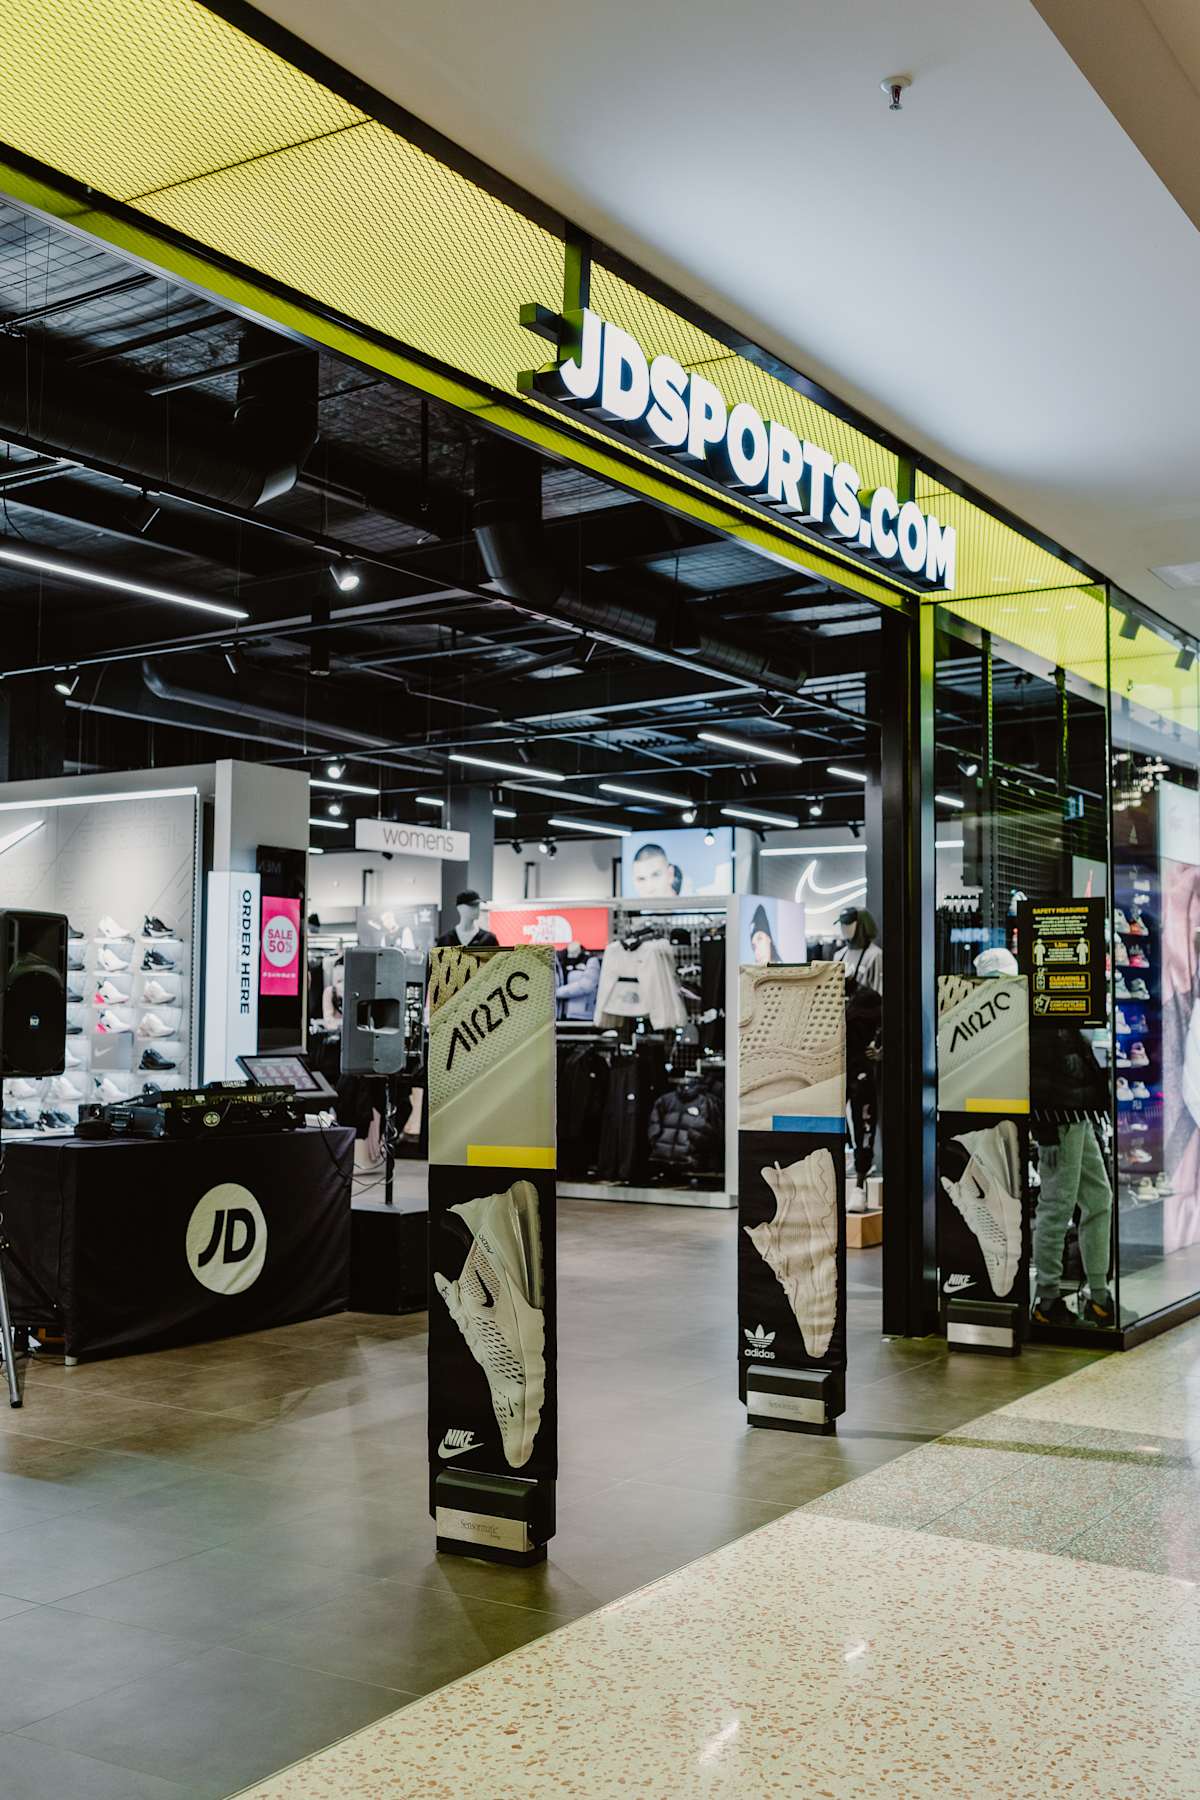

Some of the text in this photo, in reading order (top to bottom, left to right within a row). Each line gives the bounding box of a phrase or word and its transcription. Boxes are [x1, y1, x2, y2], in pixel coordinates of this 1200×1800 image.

[559, 307, 957, 590] JDSPORTS.COM
[383, 828, 454, 853] womens
[268, 928, 293, 941] SALE
[240, 889, 252, 1014] ORDER HERE
[197, 1207, 256, 1268] JD
[948, 1273, 971, 1286] NIKE
[744, 1348, 776, 1360] adidas
[444, 1428, 475, 1448] NIKE
